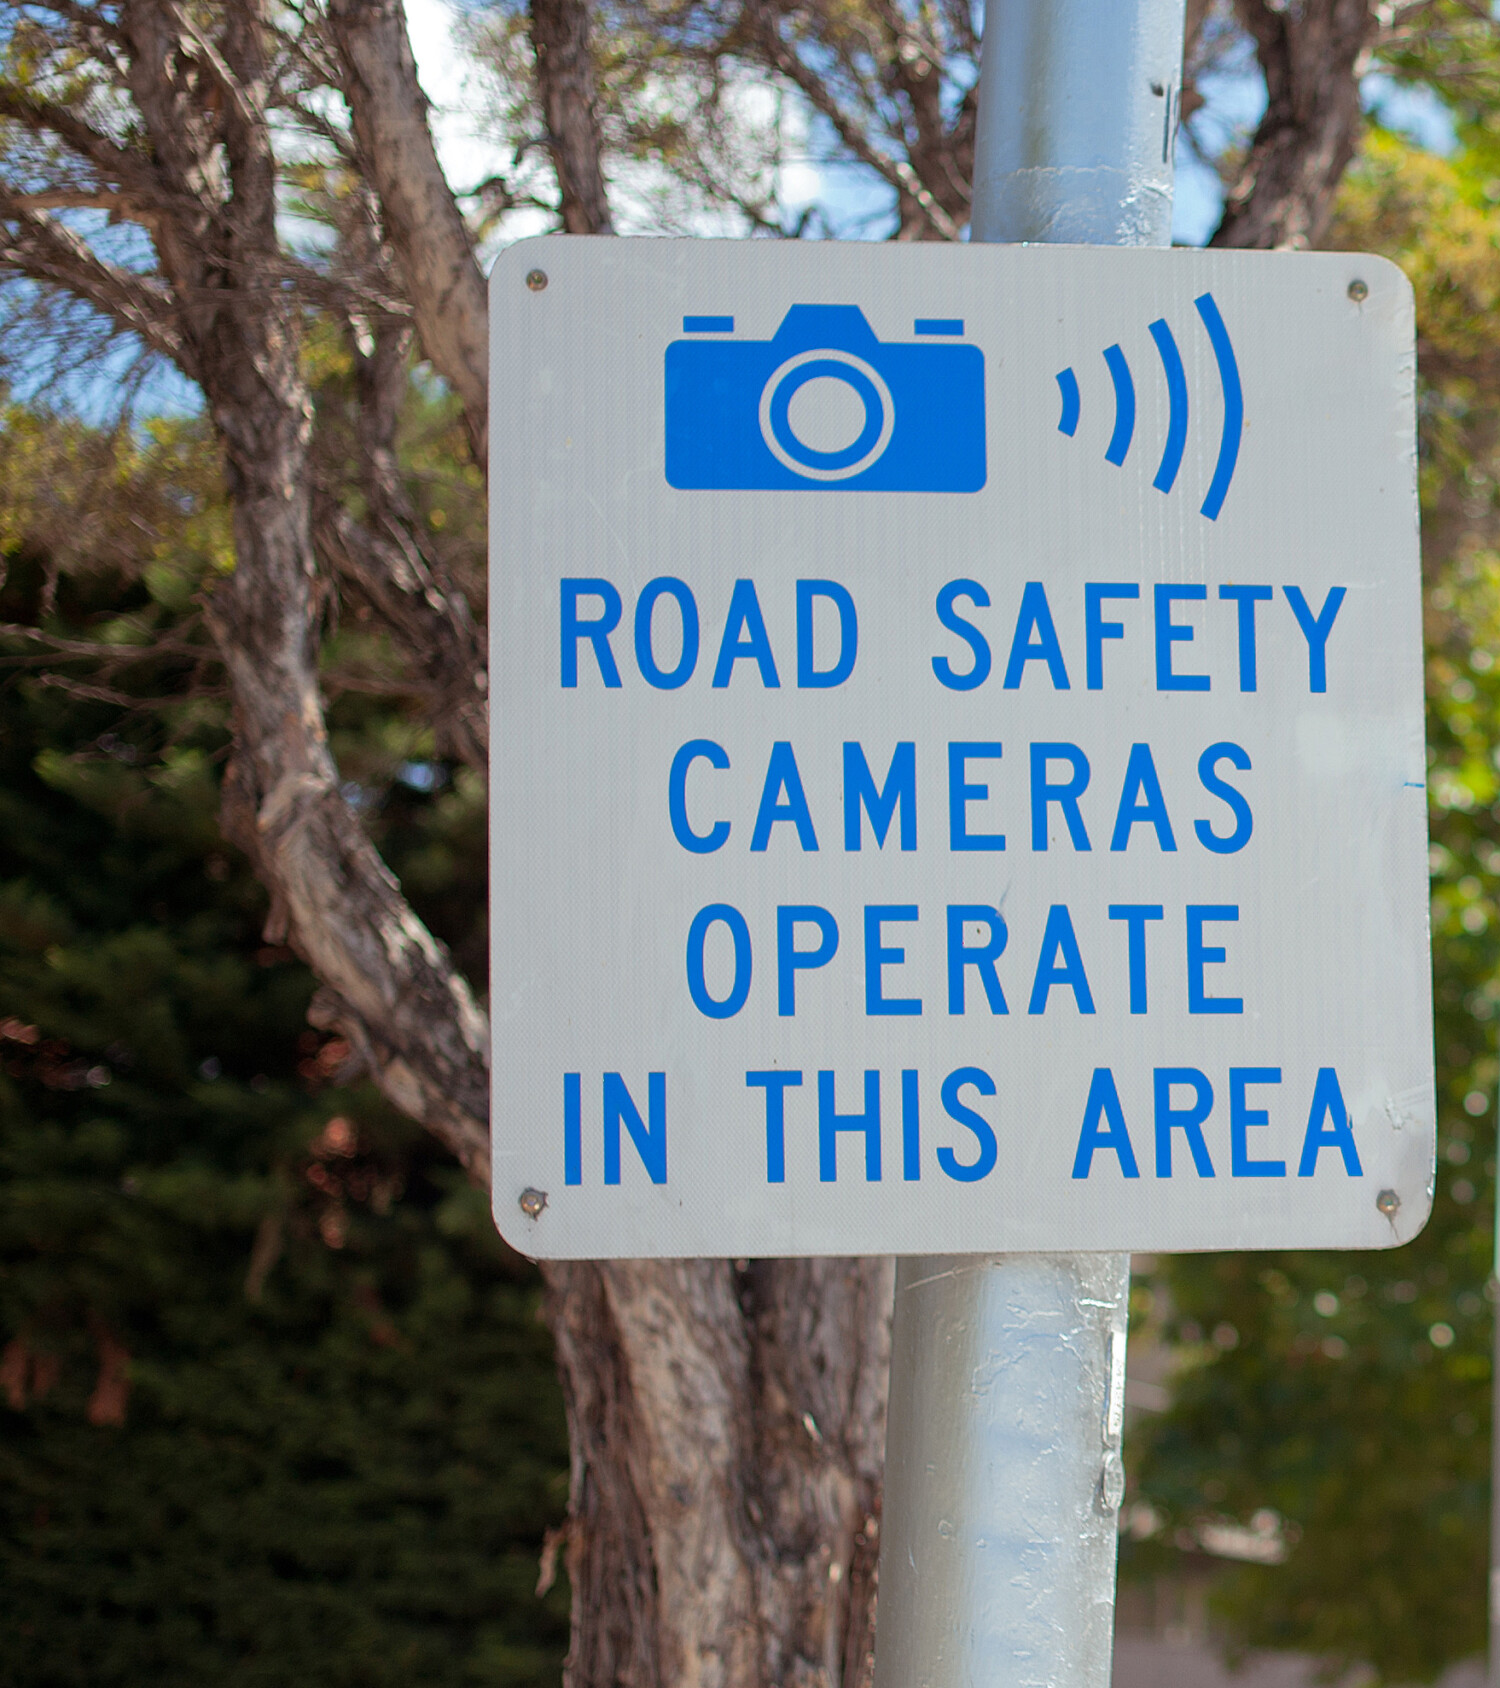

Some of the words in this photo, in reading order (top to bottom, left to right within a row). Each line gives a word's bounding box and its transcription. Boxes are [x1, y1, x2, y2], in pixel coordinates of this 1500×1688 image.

[559, 576, 859, 690] ROAD
[931, 578, 1347, 694] SAFETY
[668, 739, 1254, 855] CAMERAS
[685, 903, 1245, 1020] OPERATE
[563, 1072, 668, 1186] IN
[745, 1066, 999, 1184] THIS
[1071, 1067, 1365, 1180] AREA
